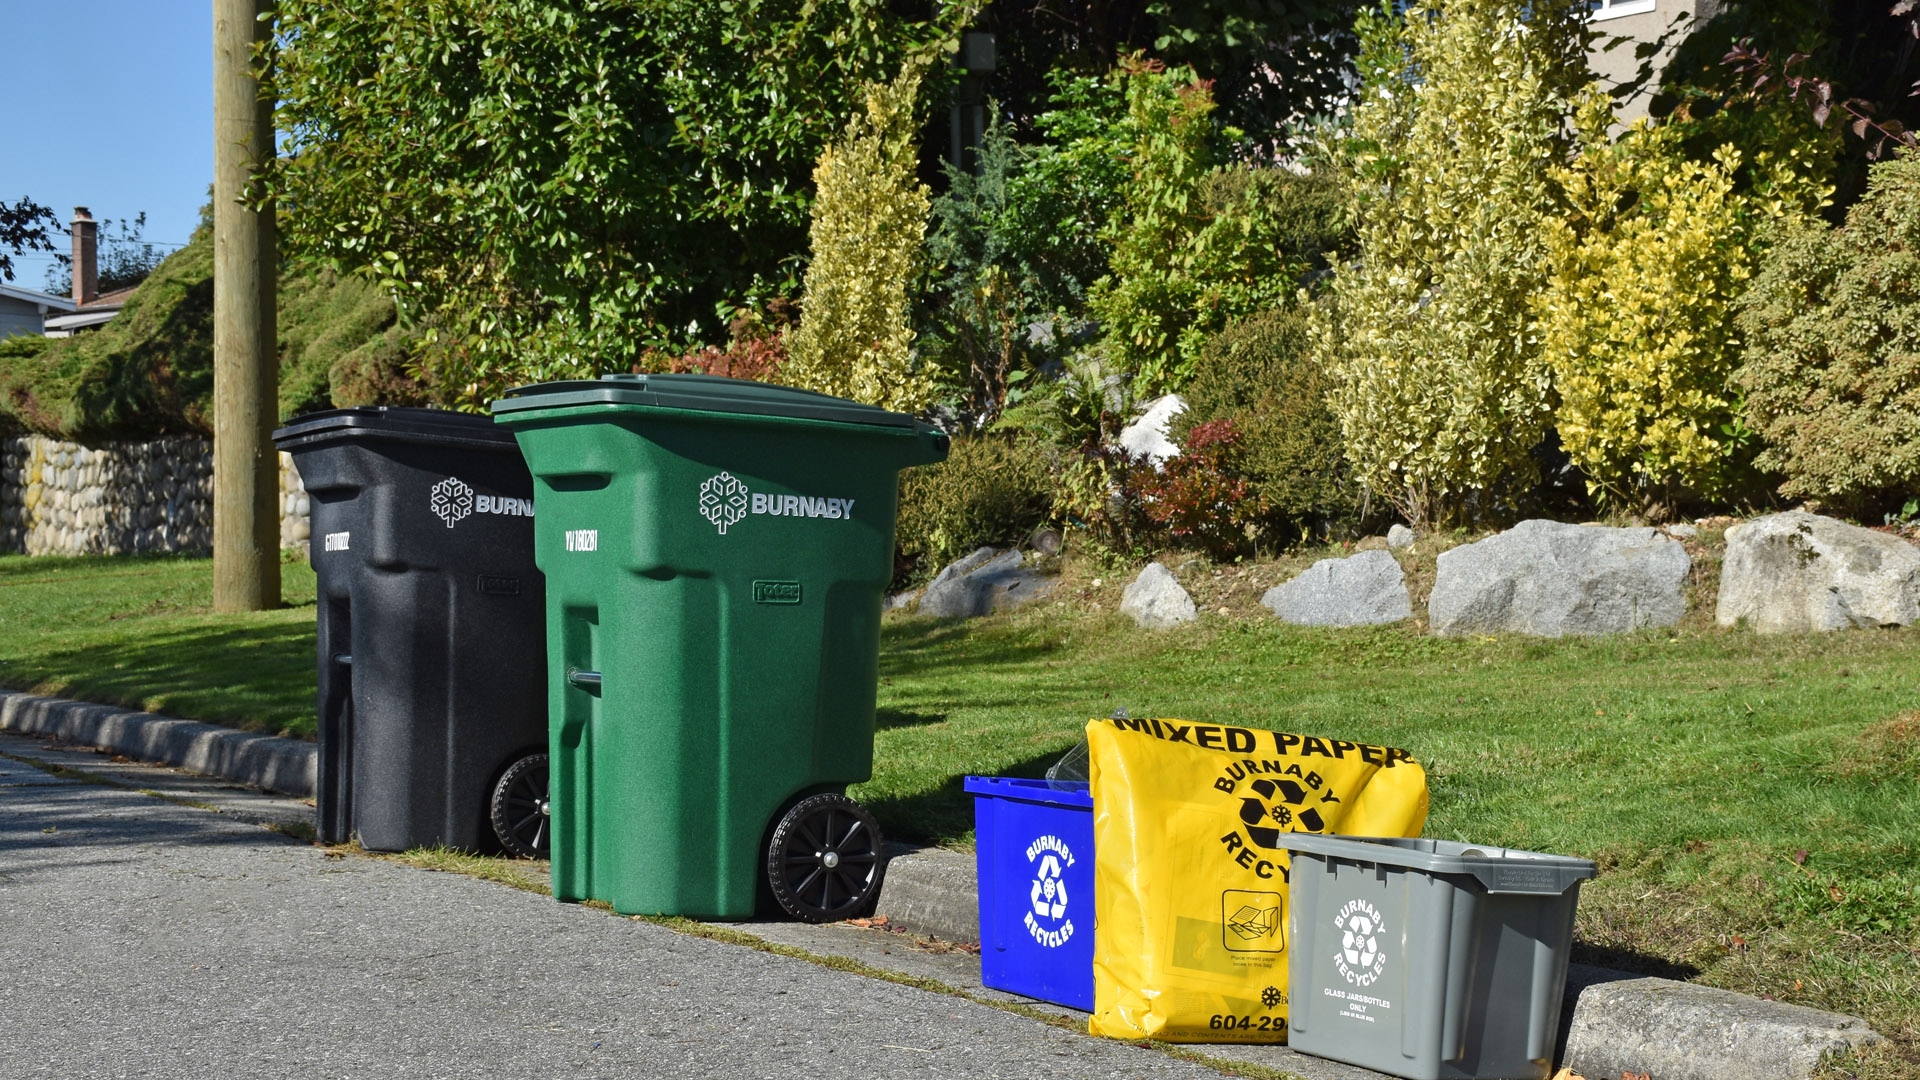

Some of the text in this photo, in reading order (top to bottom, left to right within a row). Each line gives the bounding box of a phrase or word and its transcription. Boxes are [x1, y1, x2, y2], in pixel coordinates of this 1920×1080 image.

[751, 493, 855, 520] BURNABY
[756, 583, 798, 600] Toter
[1112, 718, 1416, 769] MIXED PAPER
[1213, 759, 1341, 805] BURNABY
[1026, 834, 1076, 868] BURNABY
[1023, 910, 1074, 948] RECYCLES
[1334, 898, 1386, 933] BURNABY
[1333, 952, 1386, 987] RECYCLES
[1324, 988, 1346, 999] GLASS
[1349, 1003, 1367, 1013] ONLY
[1209, 1014, 1288, 1032] 604-29
